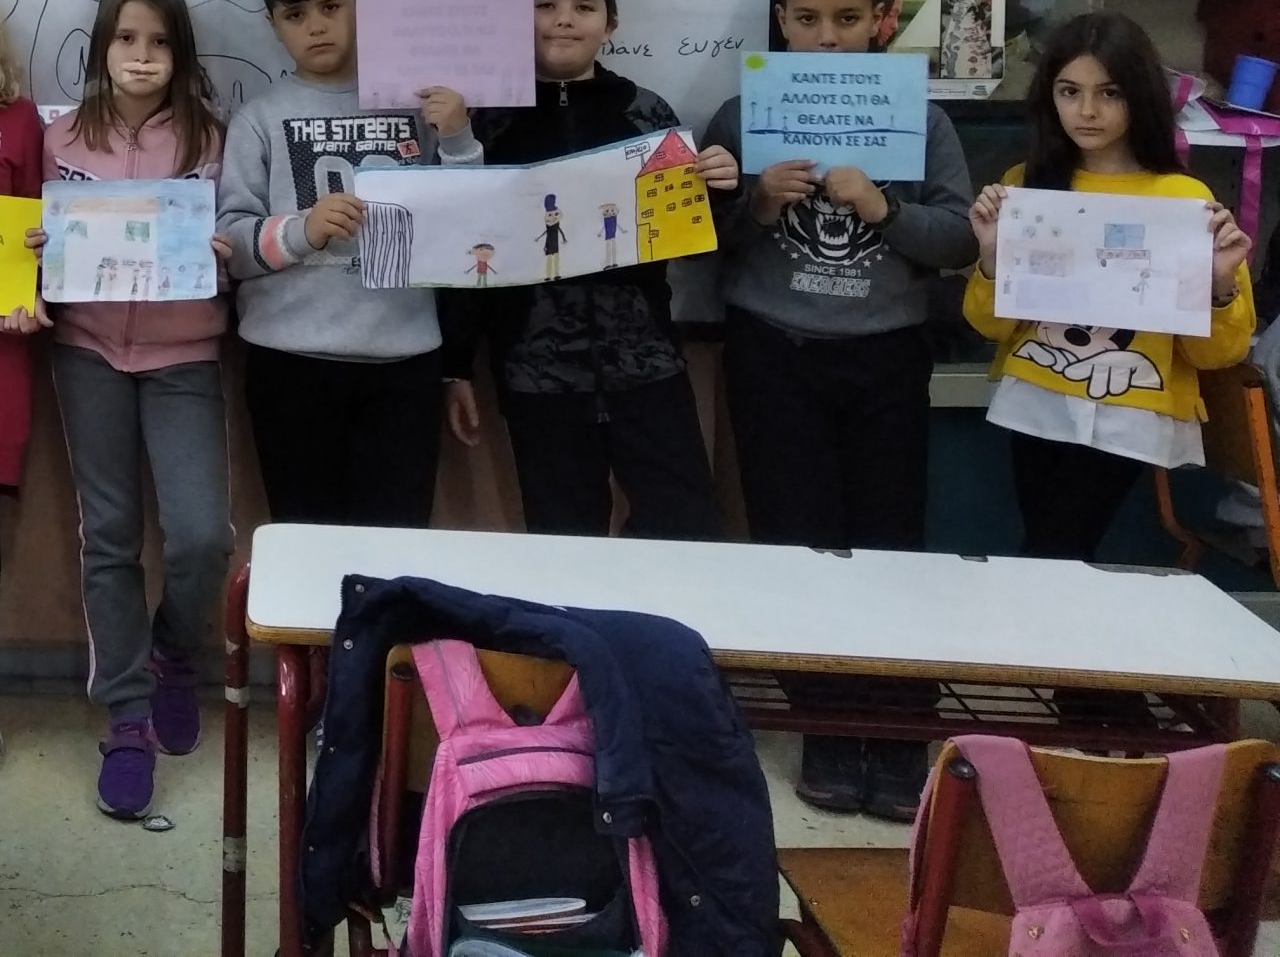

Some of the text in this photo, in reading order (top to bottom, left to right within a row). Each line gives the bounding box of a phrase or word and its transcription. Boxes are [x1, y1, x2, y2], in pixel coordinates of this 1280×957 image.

[601, 39, 653, 57] ιλάνε
[791, 73, 882, 85] ΚΑΝΤΕ ΣΤΟΥΣ
[780, 93, 890, 107] ΑΛΛΟΥΣ Ο,ΤΙ ΘΑ
[797, 114, 874, 126] ΘΕΛΑΤΕ ΝΑ
[783, 134, 887, 147] ΚΑΝΟΥΝ ΣΕ ΣΑΣ
[804, 264, 861, 277] SINCE 1981
